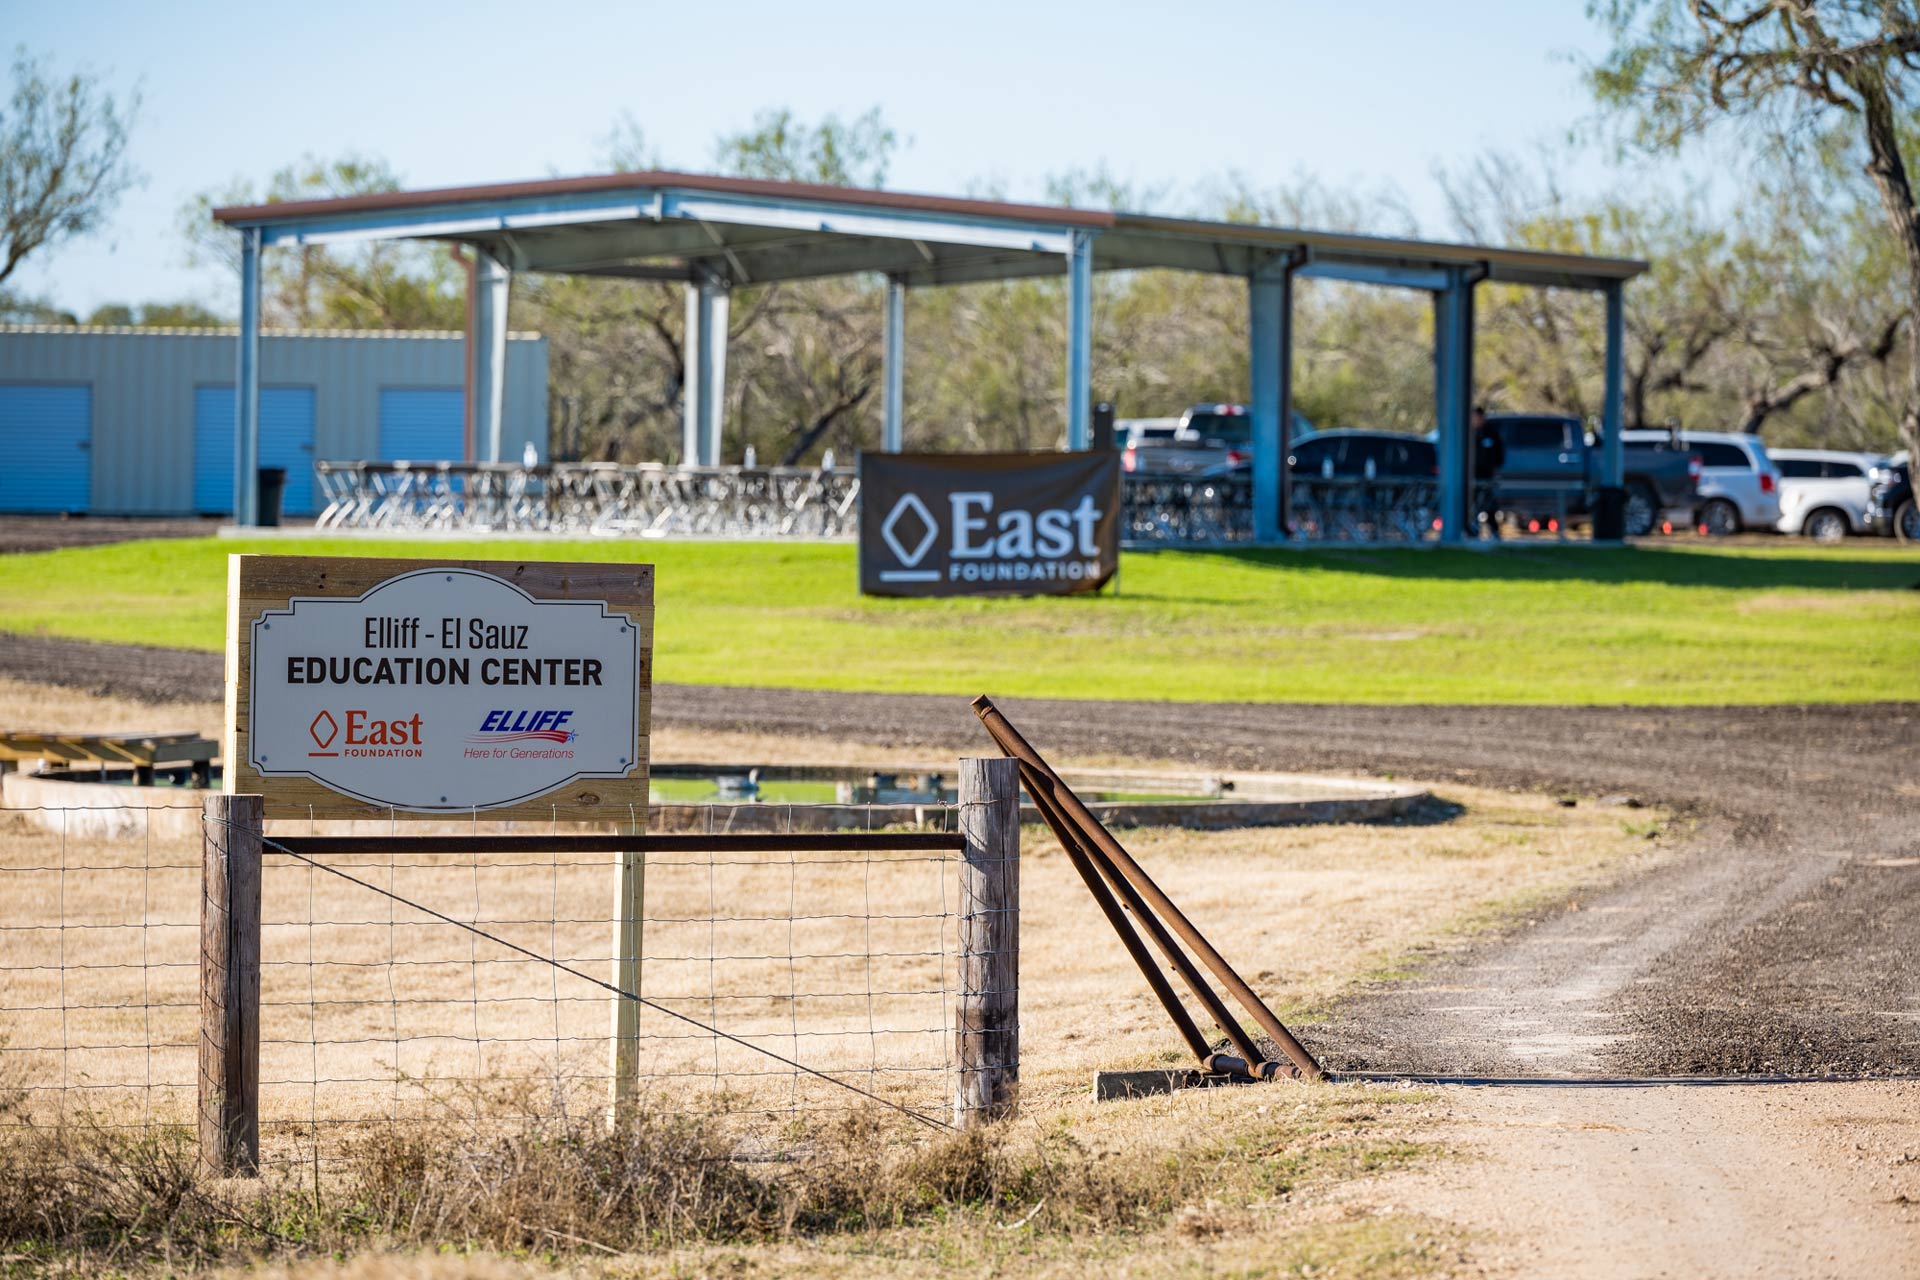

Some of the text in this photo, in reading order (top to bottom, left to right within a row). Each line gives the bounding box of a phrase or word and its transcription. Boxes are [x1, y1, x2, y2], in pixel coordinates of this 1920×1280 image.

[948, 491, 1102, 559] East
[949, 561, 1100, 581] FOUNDATION
[364, 617, 420, 649] Elliff
[441, 618, 461, 649] El
[468, 617, 529, 650] Sauz
[287, 656, 603, 687] EDUCATION CENTER
[345, 710, 424, 746] East
[479, 710, 574, 732] ELLIFF
[344, 748, 423, 758] FOUNDATION
[463, 747, 574, 760] Here for Generations
